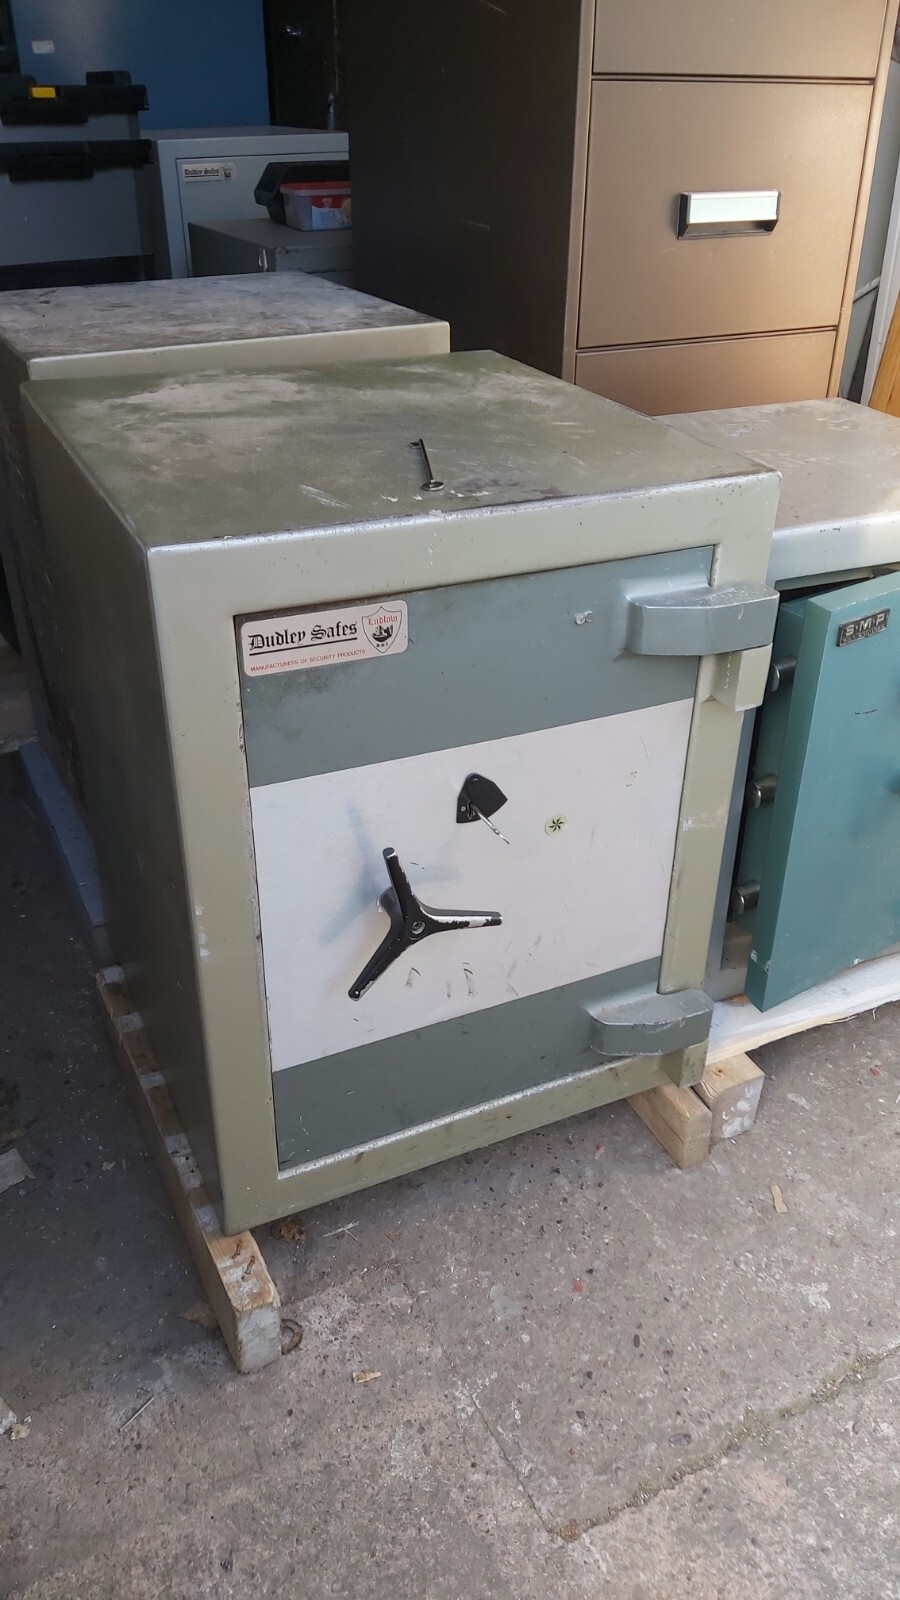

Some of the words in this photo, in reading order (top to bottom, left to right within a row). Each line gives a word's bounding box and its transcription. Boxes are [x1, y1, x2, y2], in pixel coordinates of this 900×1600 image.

[367, 615, 398, 625] Ludlow
[248, 628, 306, 650] Dudley
[310, 621, 358, 641] Safes
[250, 660, 299, 672] MANUFACTURERS
[309, 654, 336, 663] SECURITY
[337, 649, 366, 658] PRODUCTS
